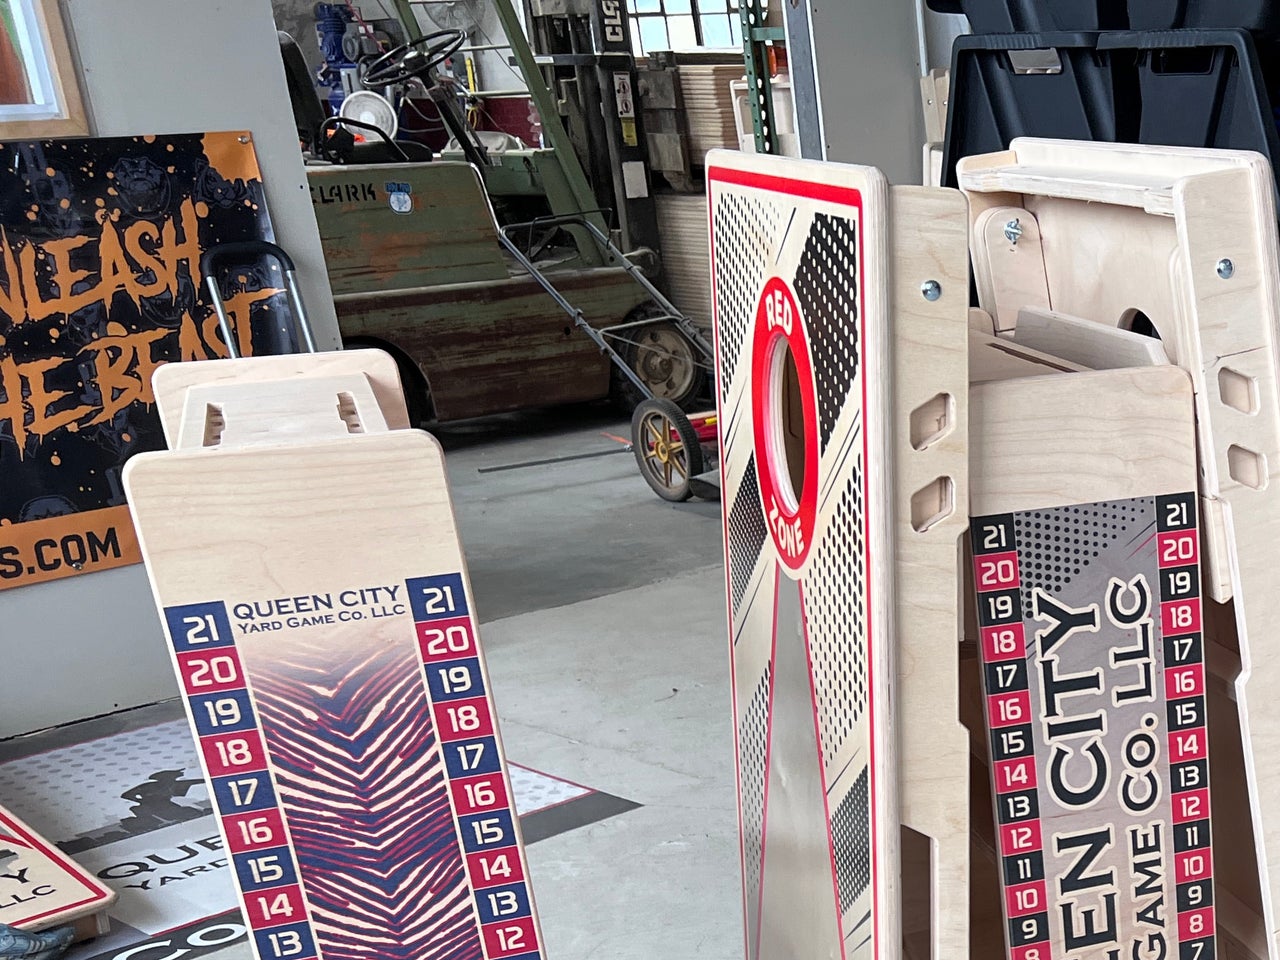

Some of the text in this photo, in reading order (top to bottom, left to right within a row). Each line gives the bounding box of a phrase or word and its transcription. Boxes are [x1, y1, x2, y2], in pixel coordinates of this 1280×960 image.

[765, 288, 793, 336] RED
[768, 494, 805, 558] ZONE
[1167, 502, 1187, 526] 21
[983, 524, 1006, 549] 21
[0, 527, 121, 579] S.COM
[981, 560, 1014, 585] 20
[1169, 572, 1191, 594] 19
[233, 585, 400, 620] QUEEN CITY
[423, 586, 455, 614] 21
[183, 614, 219, 644] 21
[238, 621, 283, 634] YARD
[286, 614, 335, 628] GAME
[370, 604, 406, 618] LLC
[425, 626, 469, 655] 20
[992, 630, 1016, 654] 18
[1109, 578, 1153, 703] LLC
[1173, 638, 1193, 659] 17
[187, 656, 237, 686] 20
[998, 698, 1022, 721] 16
[1035, 591, 1109, 807] CITY
[447, 705, 480, 732] 18
[1175, 702, 1197, 723] 15
[215, 739, 252, 767] 18
[1004, 763, 1028, 786] 14
[1179, 766, 1199, 786] 13
[464, 781, 495, 808] 16
[237, 817, 272, 845] 16
[1011, 827, 1032, 849] 12
[1186, 826, 1198, 846] 11
[97, 834, 224, 880] QUE
[479, 855, 512, 881] 14
[258, 893, 293, 920] 14
[1016, 888, 1038, 910] 10
[1188, 885, 1202, 905] 9
[496, 926, 525, 951] 12
[1191, 942, 1204, 960] 7
